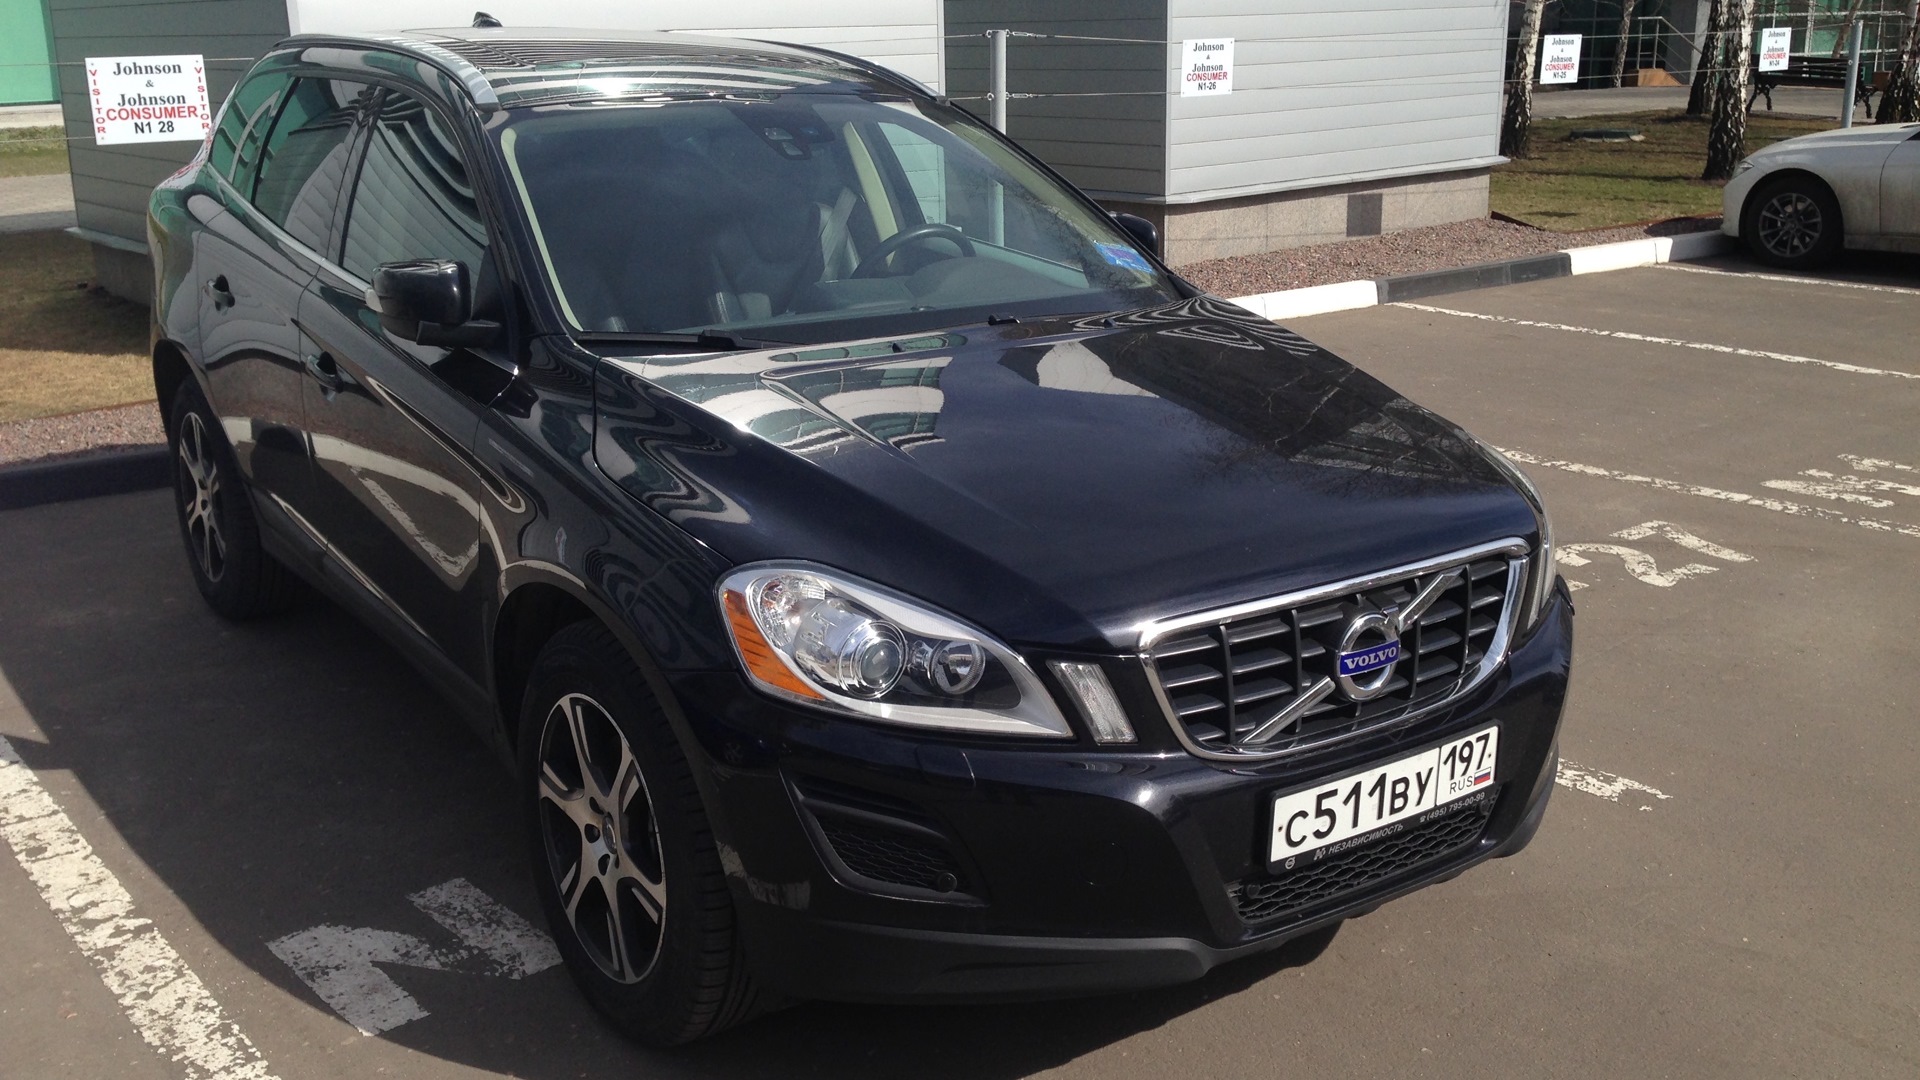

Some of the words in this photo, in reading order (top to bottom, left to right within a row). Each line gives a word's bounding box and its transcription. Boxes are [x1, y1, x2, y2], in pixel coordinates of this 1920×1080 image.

[1193, 42, 1225, 52] Johnson
[1552, 37, 1575, 46] Johnson
[1550, 55, 1573, 63] Johnson
[1763, 52, 1787, 60] CONSUMER
[113, 62, 182, 76] Johnson
[1192, 63, 1224, 73] Johnson
[1545, 63, 1575, 71] CONSUMER
[145, 79, 154, 88] &
[1186, 71, 1228, 82] CONSUMER
[1197, 81, 1217, 91] N1-26
[89, 69, 106, 134] VISITOR
[118, 93, 186, 107] Johnson
[194, 66, 210, 130] VISITOR
[106, 105, 198, 121] CONSUMER
[134, 122, 152, 134] N1
[158, 120, 175, 133] 28
[1344, 646, 1397, 669] VOLVO
[1443, 732, 1491, 781] 197
[1450, 776, 1474, 794] RUS
[1427, 806, 1447, 821] (495)
[1449, 792, 1485, 812] 795-00-99
[1328, 823, 1404, 854] НЕЗАВИСИМОСТЬ
